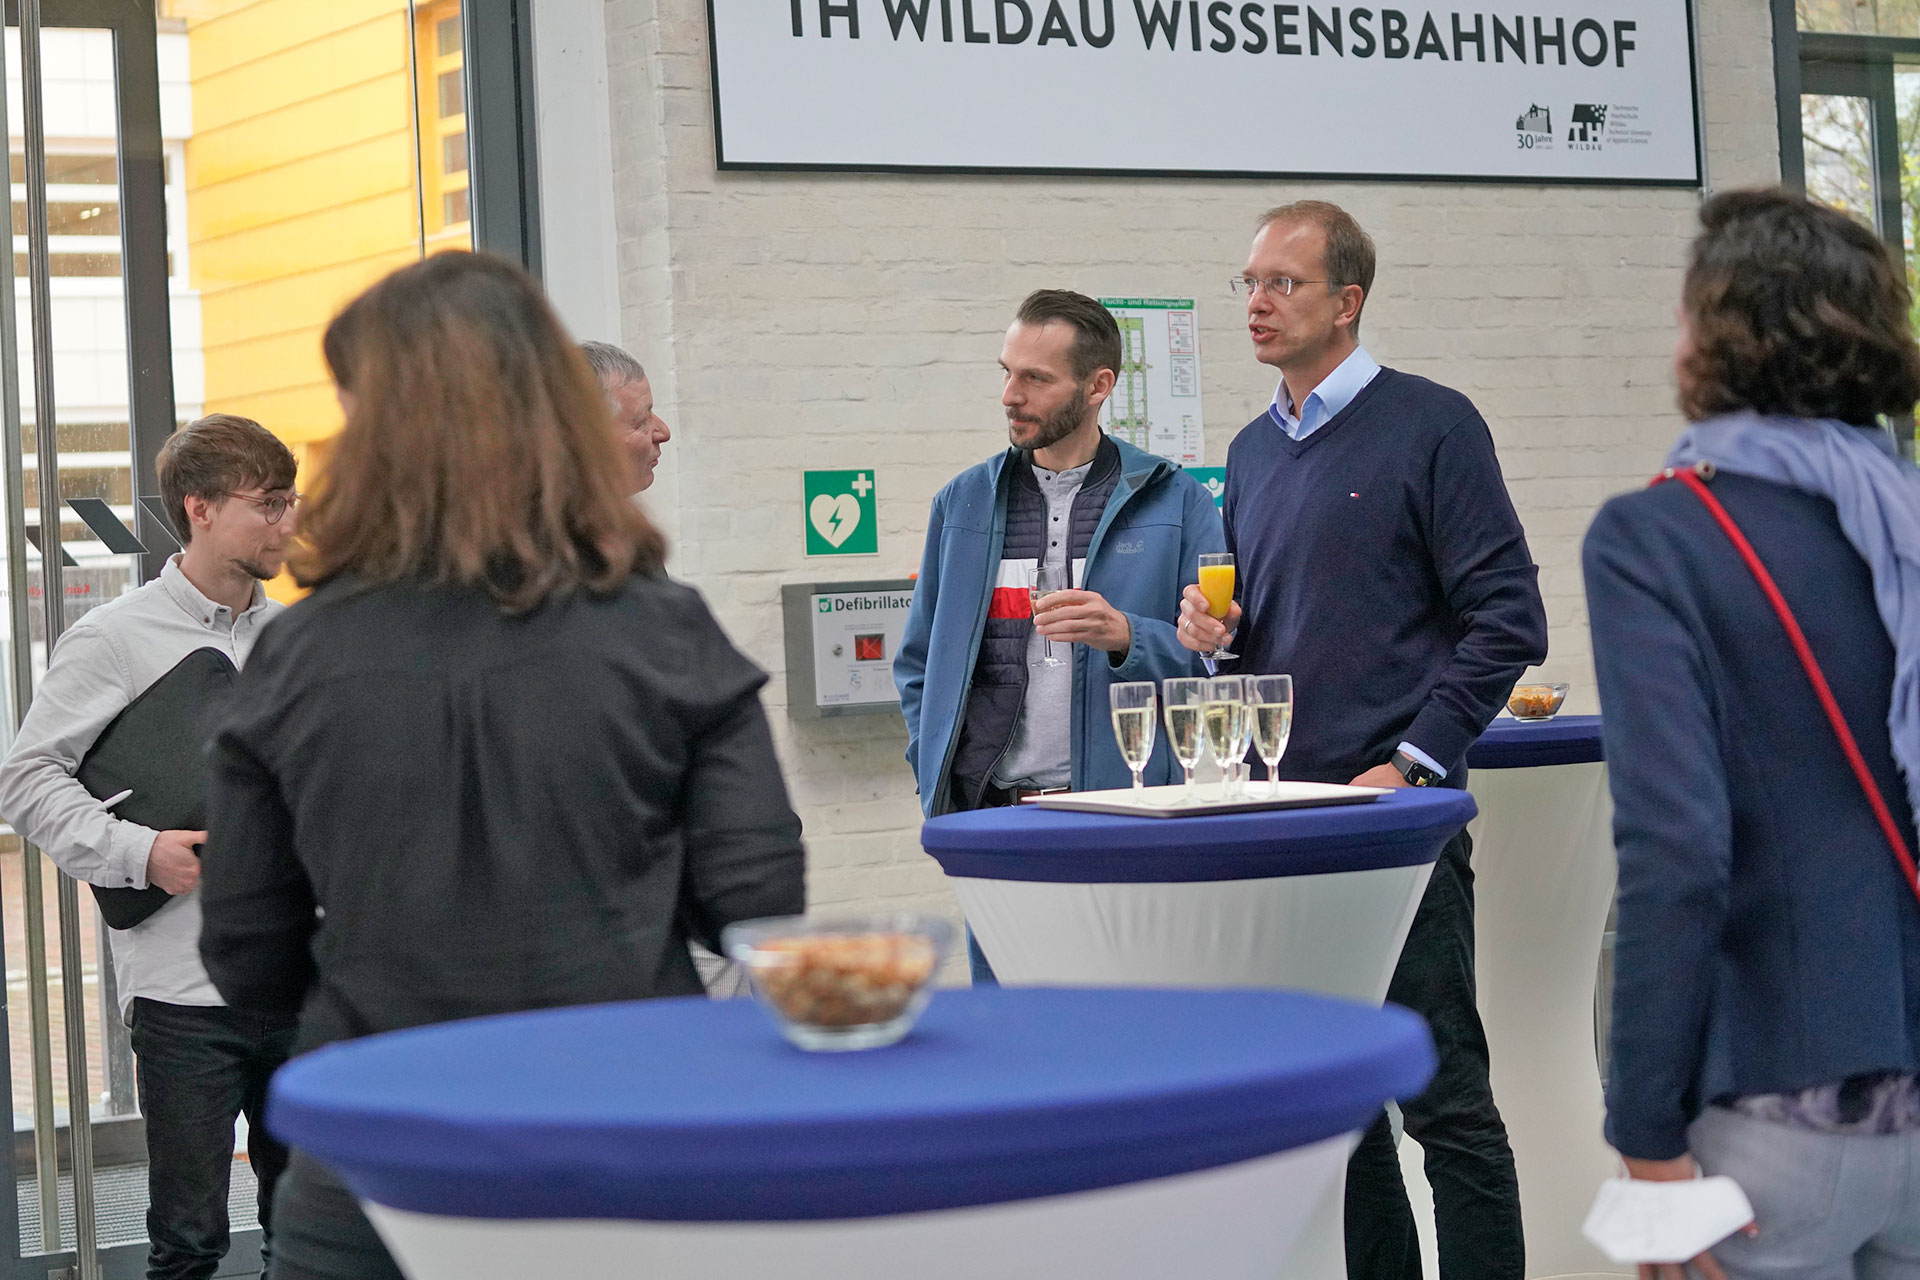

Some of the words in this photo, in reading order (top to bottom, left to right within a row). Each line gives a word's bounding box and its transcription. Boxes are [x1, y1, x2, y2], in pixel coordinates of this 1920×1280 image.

[881, 0, 1116, 48] WILDAU
[1132, 0, 1637, 68] WISSENSBAHNHOF
[1516, 133, 1534, 149] 30
[1567, 143, 1603, 151] WILDAU
[835, 596, 912, 611] Defibrillato
